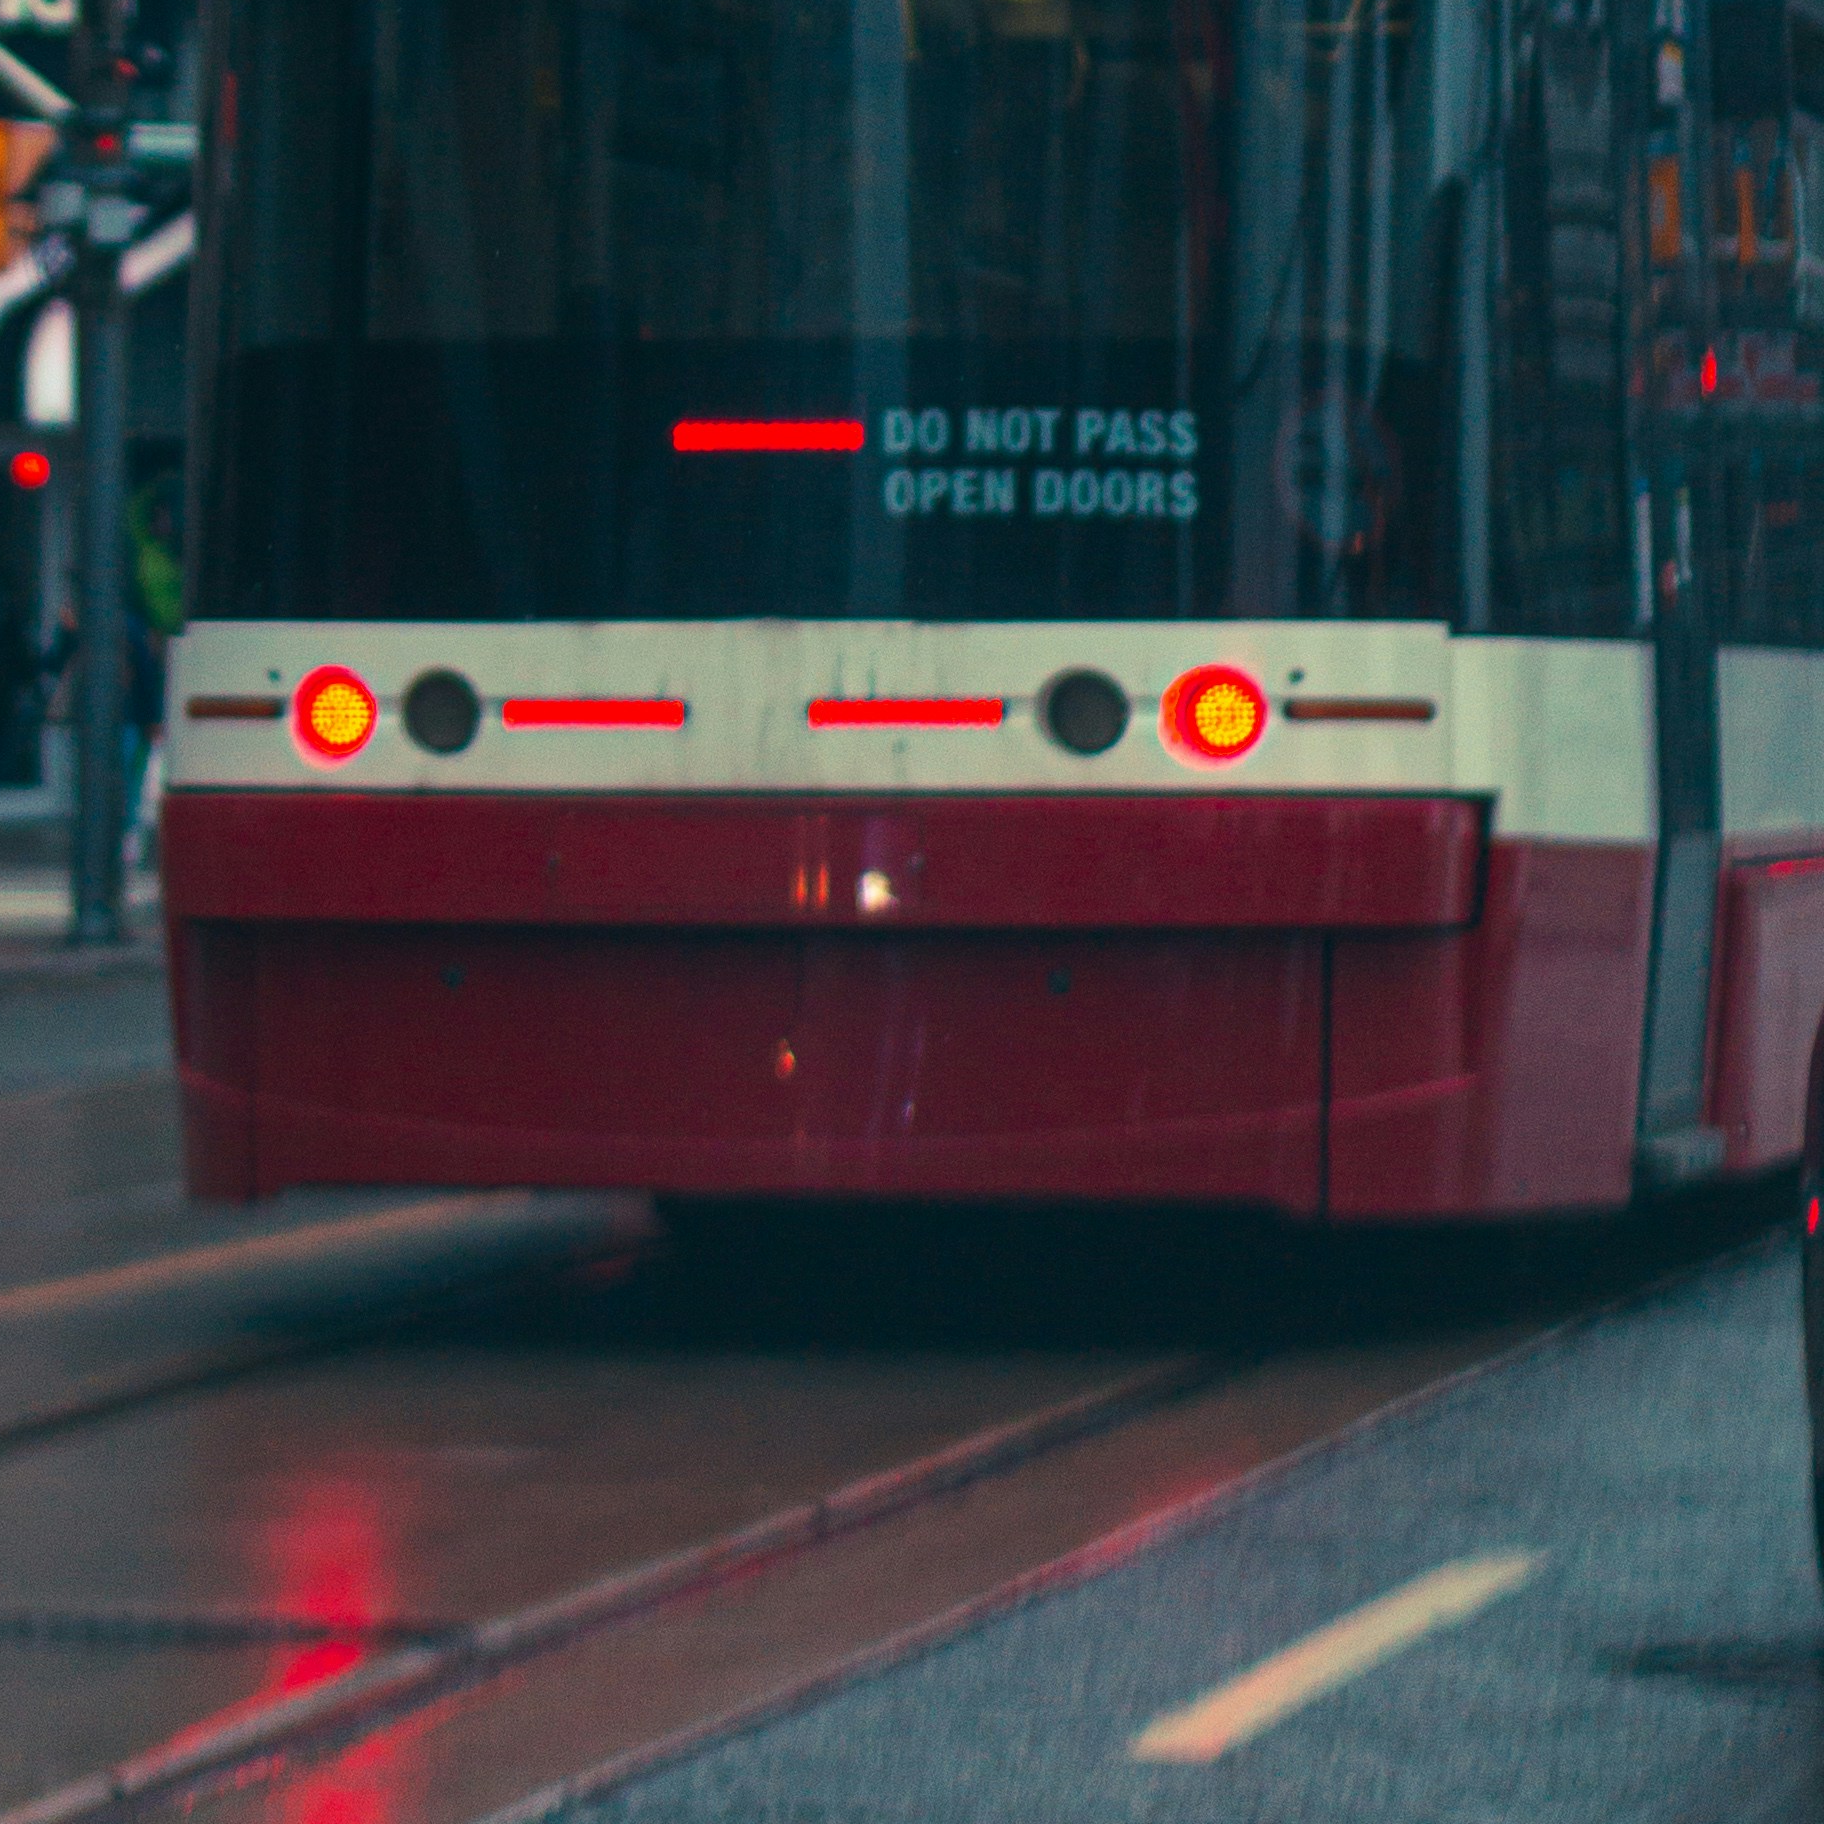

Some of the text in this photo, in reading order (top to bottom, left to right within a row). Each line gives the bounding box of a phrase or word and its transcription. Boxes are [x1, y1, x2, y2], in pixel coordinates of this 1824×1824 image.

[881, 405, 1199, 458] DO NOT PASS
[881, 466, 1200, 519] OPEN DOORS
